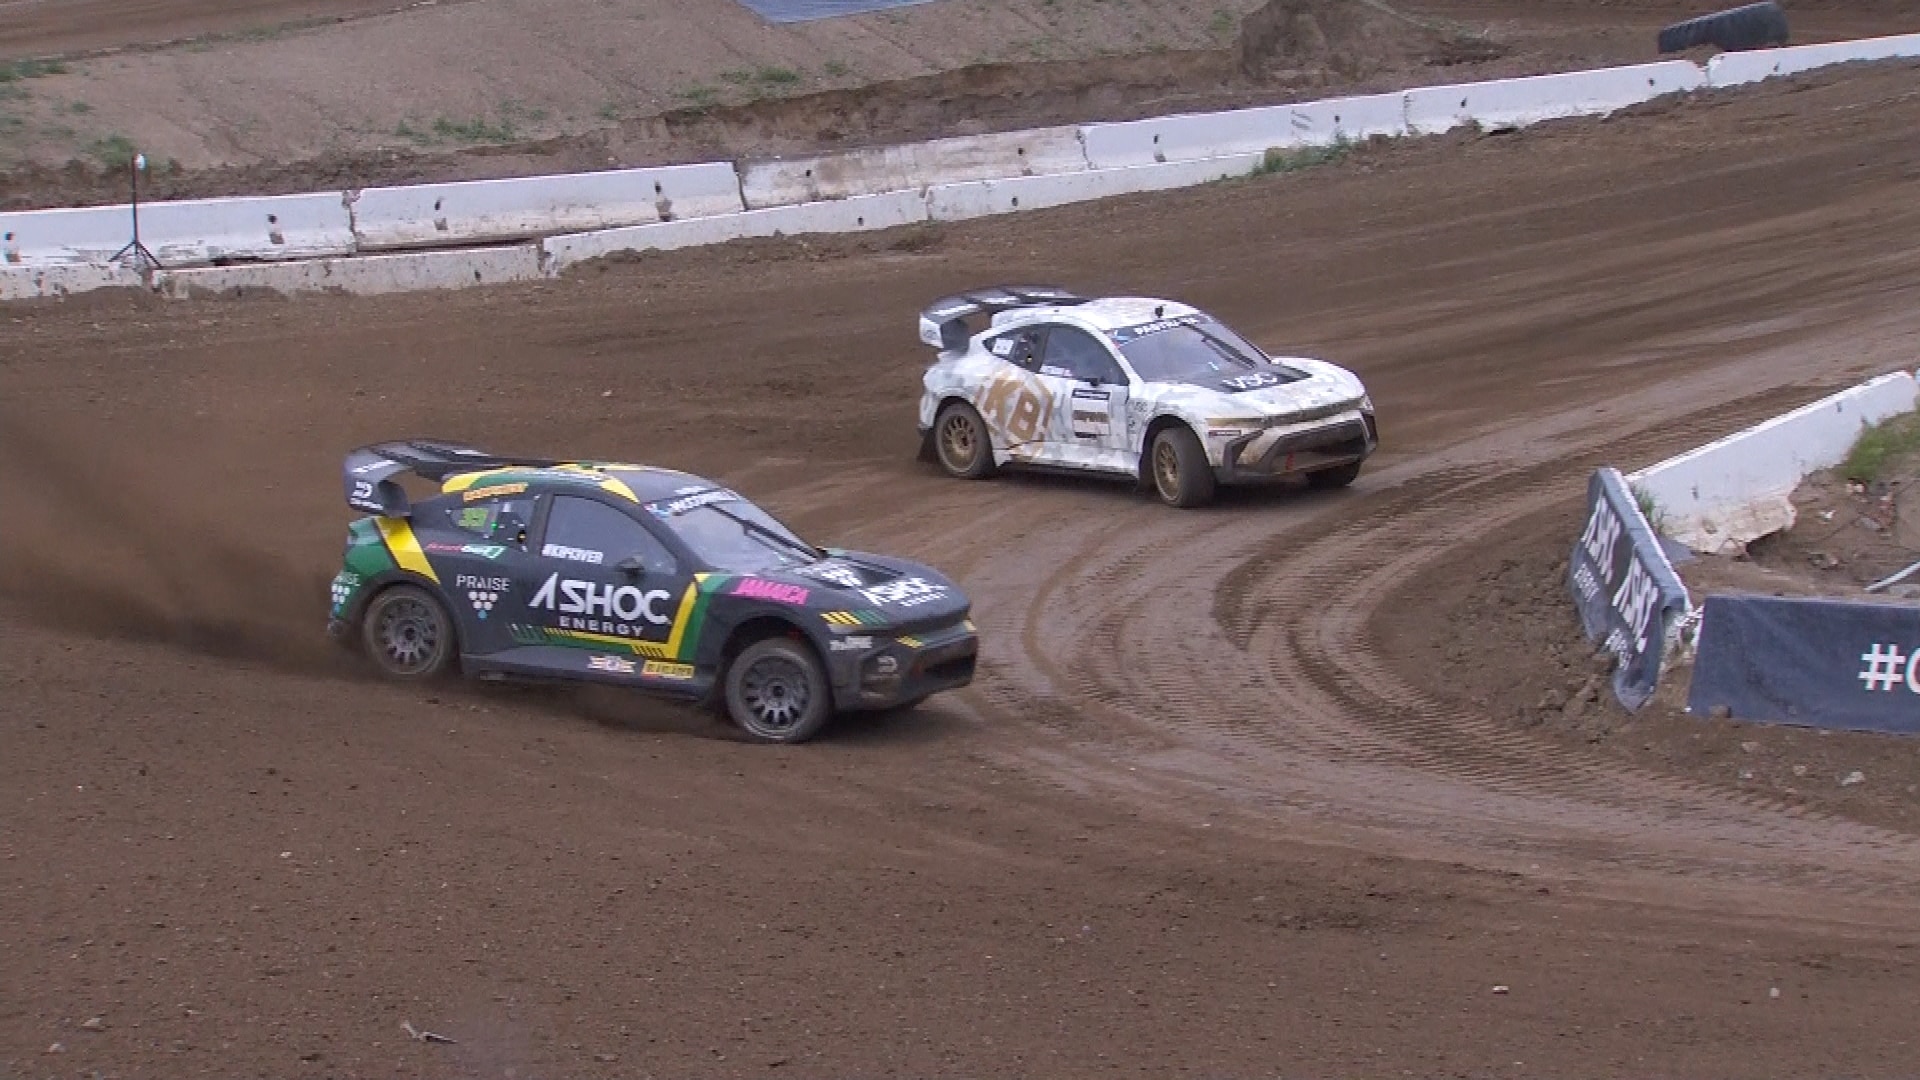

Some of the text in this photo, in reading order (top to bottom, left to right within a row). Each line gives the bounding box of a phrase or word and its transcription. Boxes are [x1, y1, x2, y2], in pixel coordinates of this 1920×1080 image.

[455, 573, 511, 592] PRAISE
[528, 571, 672, 625] ASHOC
[558, 615, 644, 637] ENERGY
